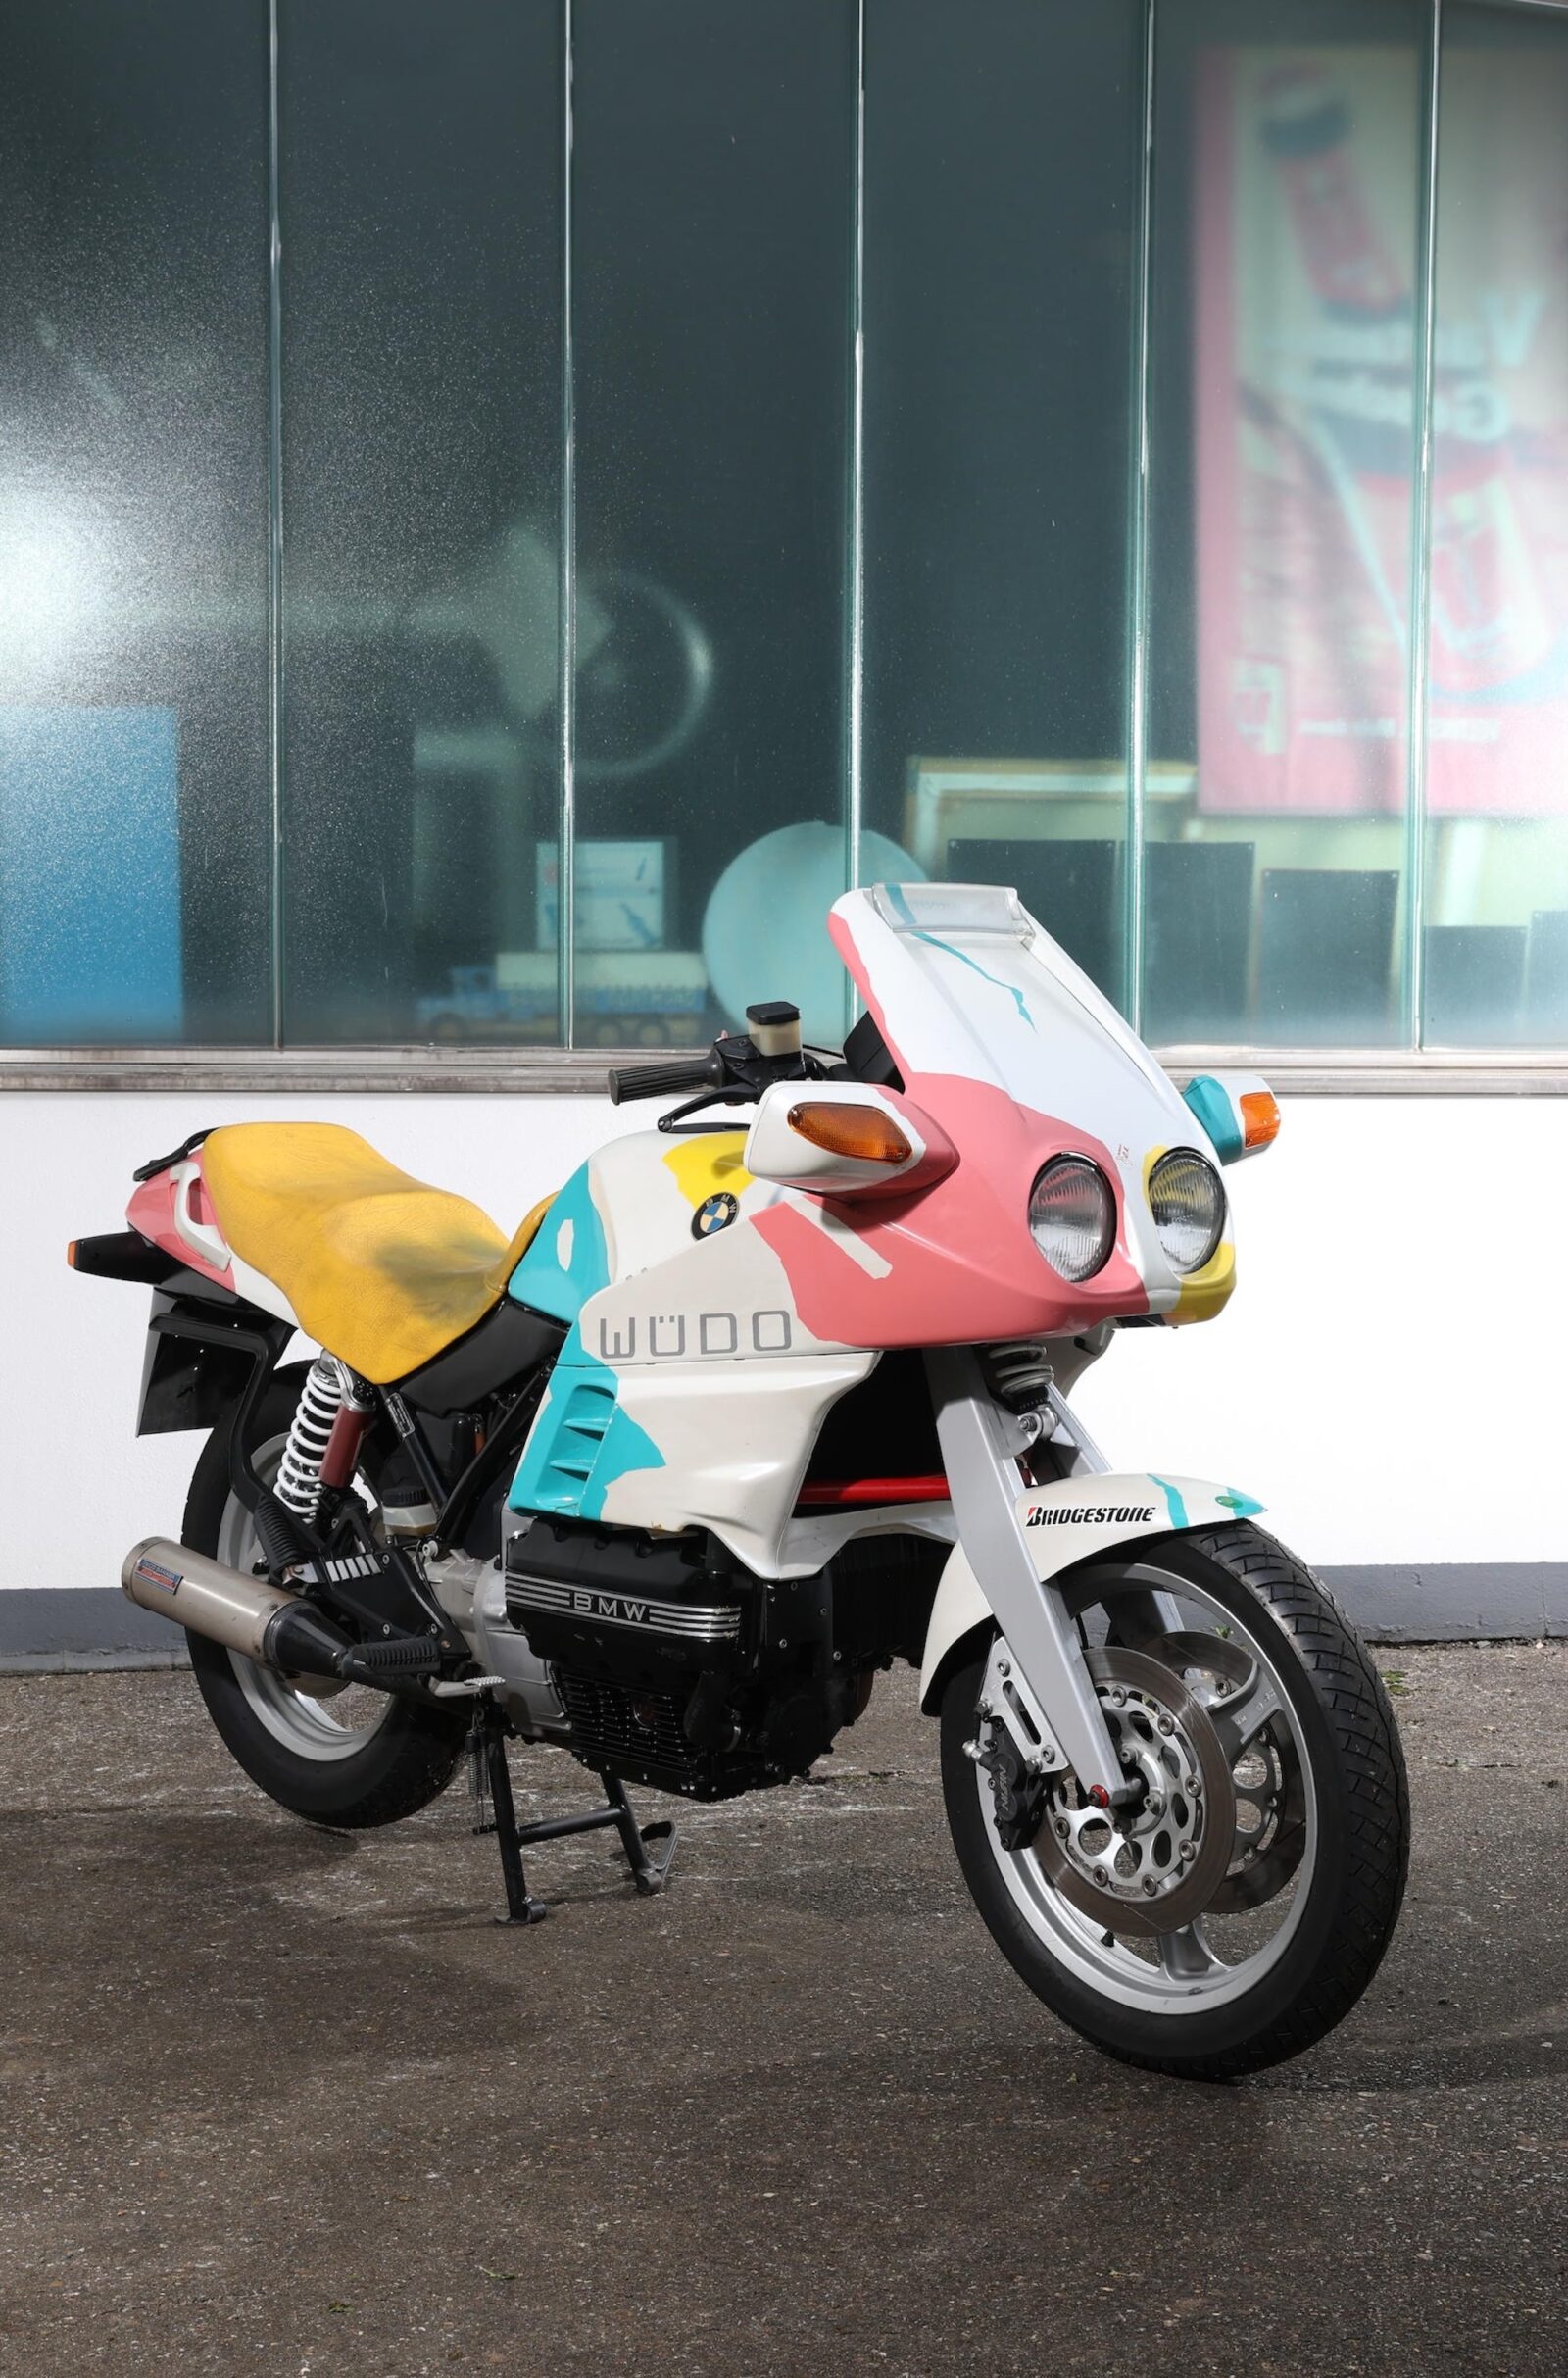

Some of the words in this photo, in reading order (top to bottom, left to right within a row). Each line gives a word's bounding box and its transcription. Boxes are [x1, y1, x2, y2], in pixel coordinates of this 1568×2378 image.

[705, 1194, 737, 1214] BMW
[600, 1310, 792, 1360] WÜDO
[1025, 1506, 1156, 1528] BRIDGESTONE
[573, 1591, 647, 1622] BMW
